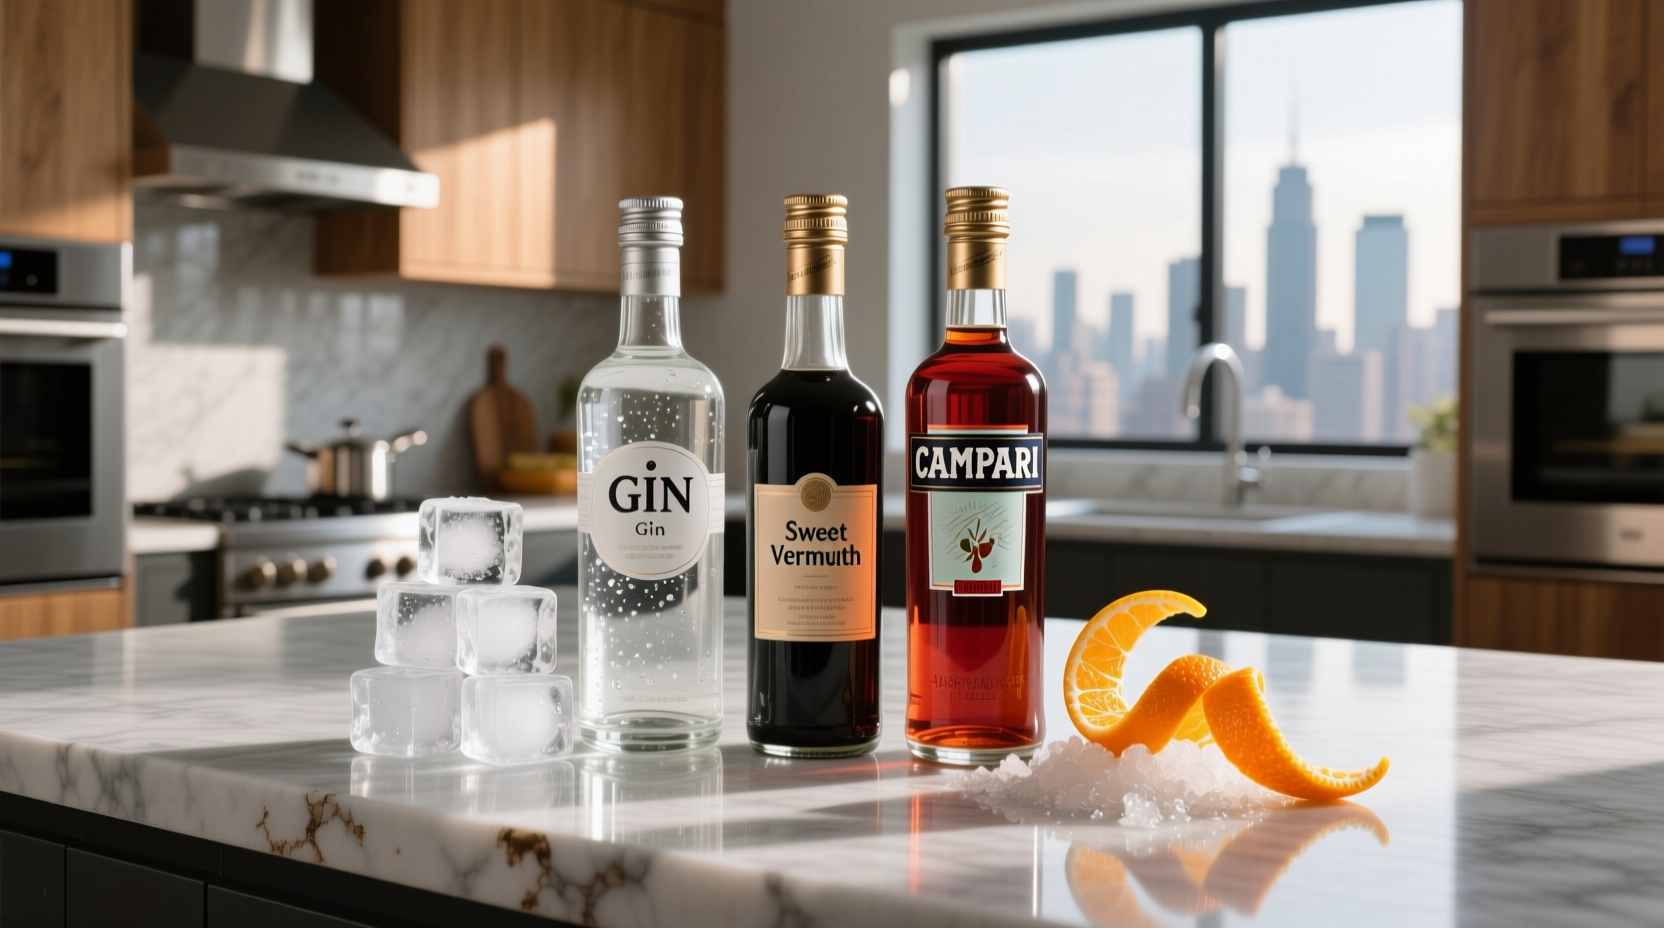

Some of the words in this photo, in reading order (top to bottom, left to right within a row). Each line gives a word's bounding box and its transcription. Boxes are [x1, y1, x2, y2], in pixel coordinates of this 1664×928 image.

[915, 446, 1039, 479] CAMPARI
[635, 521, 665, 536] Gin
[785, 520, 847, 542] Sweet
